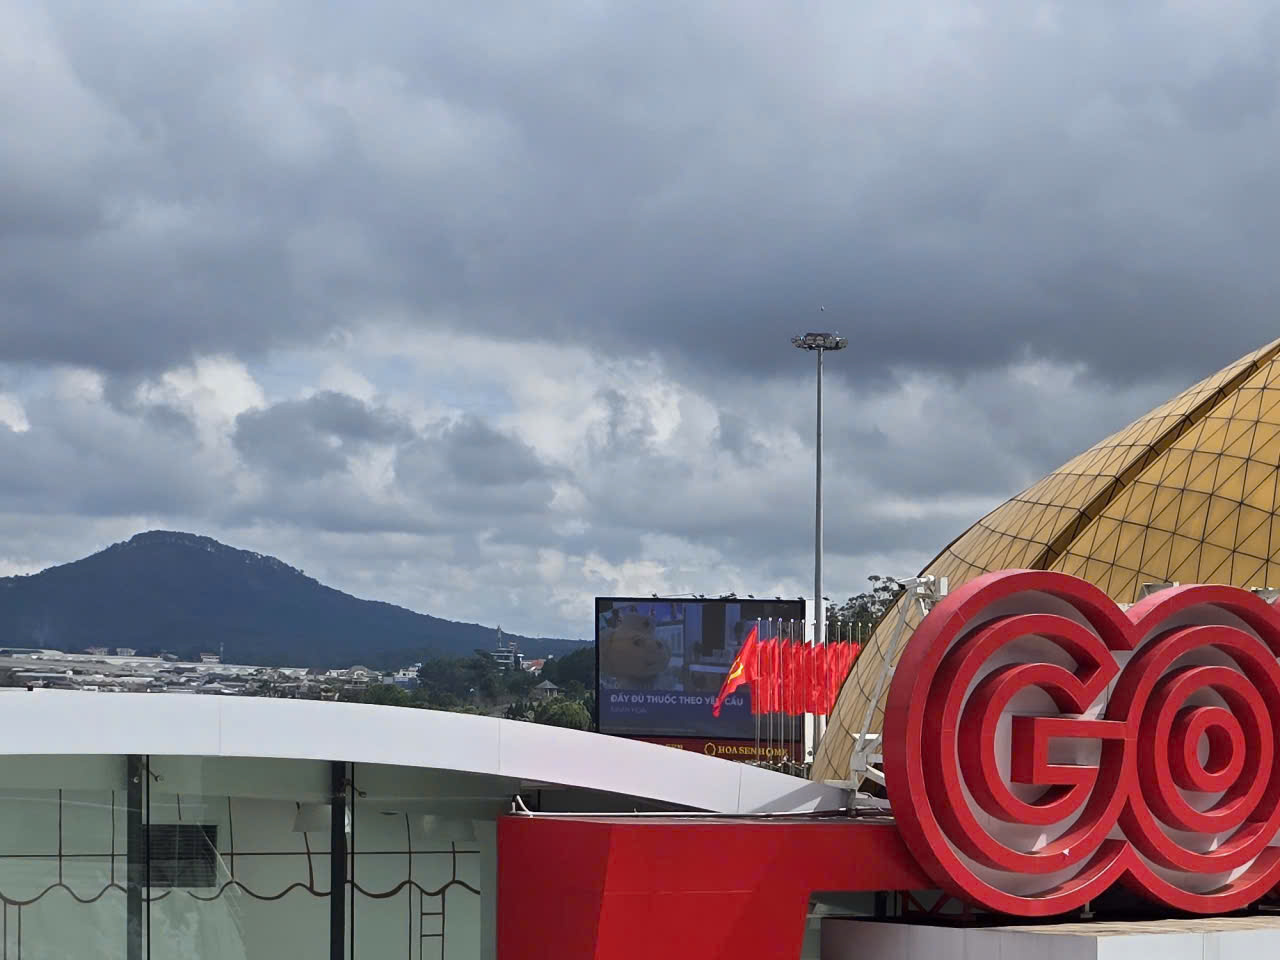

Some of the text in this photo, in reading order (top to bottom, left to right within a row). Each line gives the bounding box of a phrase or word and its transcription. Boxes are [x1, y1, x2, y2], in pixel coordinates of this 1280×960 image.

[680, 696, 702, 705] THEO
[718, 746, 737, 754] HOA
[739, 746, 757, 755] SEN
